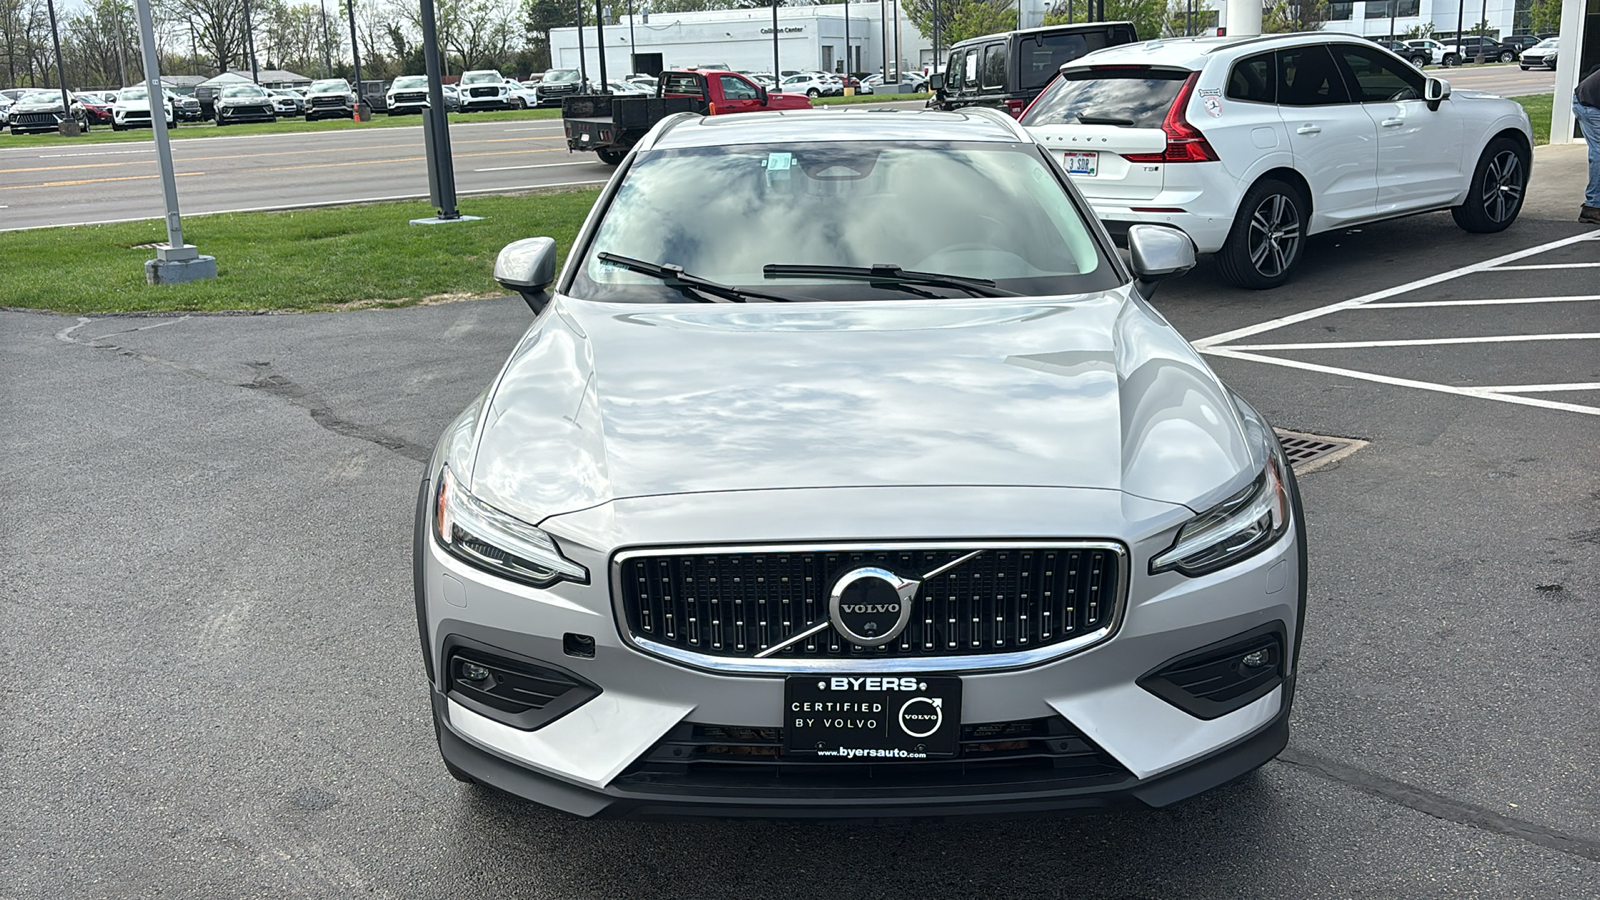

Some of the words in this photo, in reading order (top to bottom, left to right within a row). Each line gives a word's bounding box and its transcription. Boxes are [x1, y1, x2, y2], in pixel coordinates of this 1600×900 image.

[1069, 158, 1074, 170] 3
[841, 603, 900, 613] VOLVO
[830, 677, 918, 691] BYERS
[791, 702, 882, 713] CERTIFIED
[795, 718, 815, 728] BY
[823, 719, 878, 729] VOLVO
[817, 746, 927, 759] www.byersauto.com
